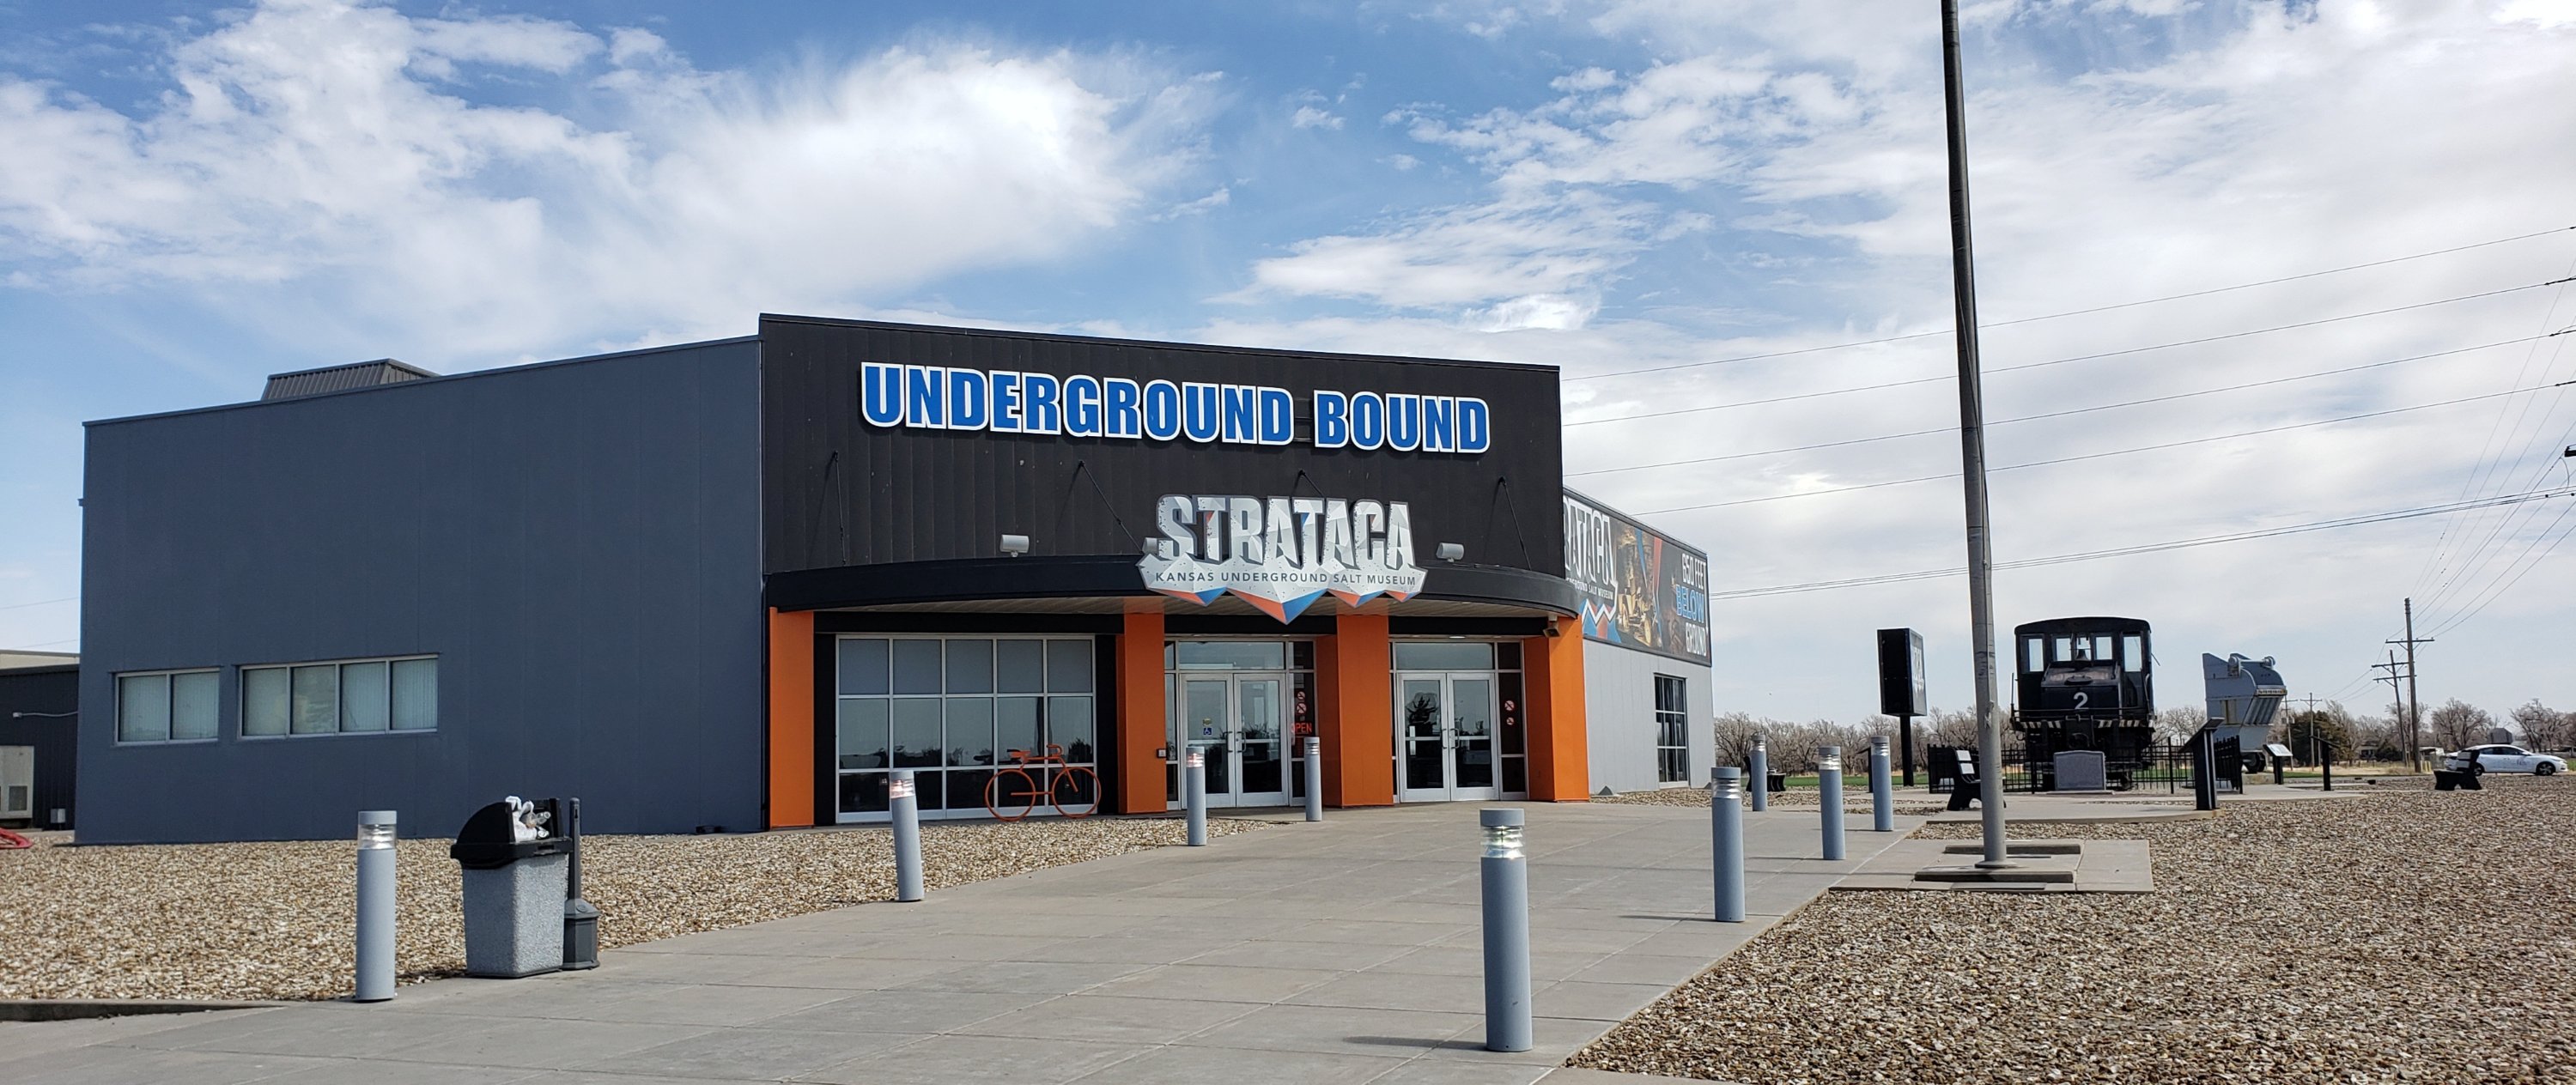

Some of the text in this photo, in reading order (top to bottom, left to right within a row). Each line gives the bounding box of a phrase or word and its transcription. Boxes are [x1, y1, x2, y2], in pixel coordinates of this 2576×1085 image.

[861, 362, 1491, 453] UNDERGROUND BOUND
[1157, 494, 1419, 569] STRATACA
[1156, 572, 1416, 585] KANSAS UNDERGROUND SALT MUSEUM
[1681, 553, 1694, 586] 650
[1676, 584, 1704, 624] BELOW
[1686, 621, 1707, 657] GROUND
[2073, 692, 2089, 710] 2
[1291, 722, 1313, 733] OPEN
